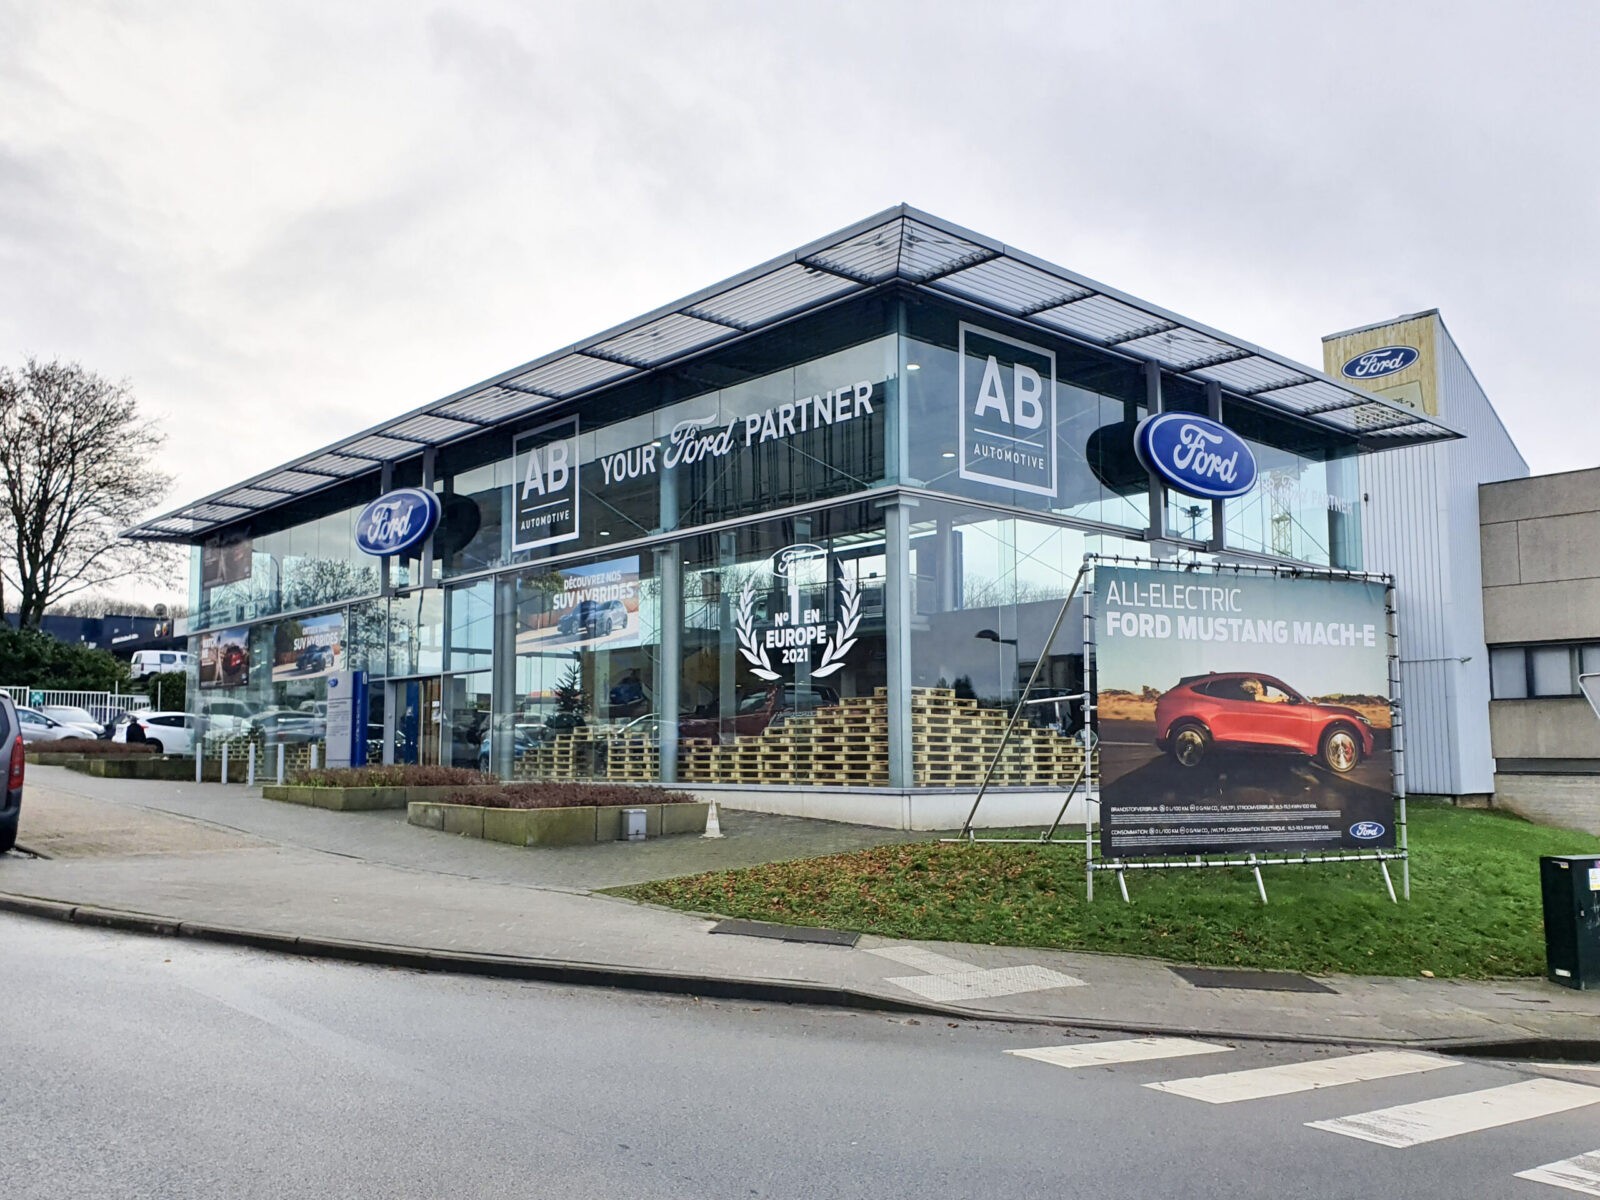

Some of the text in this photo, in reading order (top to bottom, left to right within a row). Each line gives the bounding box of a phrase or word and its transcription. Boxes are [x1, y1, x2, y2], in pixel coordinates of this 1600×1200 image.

[1355, 350, 1404, 376] Ford
[974, 354, 1043, 429] AB
[601, 380, 875, 485] YOUR Ford PARTNER
[973, 443, 1044, 470] AUTOMOTIVE
[1173, 423, 1239, 484] Ford
[521, 439, 569, 500] AB
[367, 499, 413, 545] Ford
[520, 509, 570, 530] AUTOMOTIVE
[553, 581, 634, 610] SUV HYBRIDES
[1106, 580, 1242, 612] ALL-ELECTRIC
[803, 608, 820, 624] EN
[1106, 611, 1376, 647] FORD MUSTANG MACH-E
[765, 625, 827, 649] EUROPE
[782, 648, 809, 664] 2021
[1356, 823, 1379, 837] Ford
